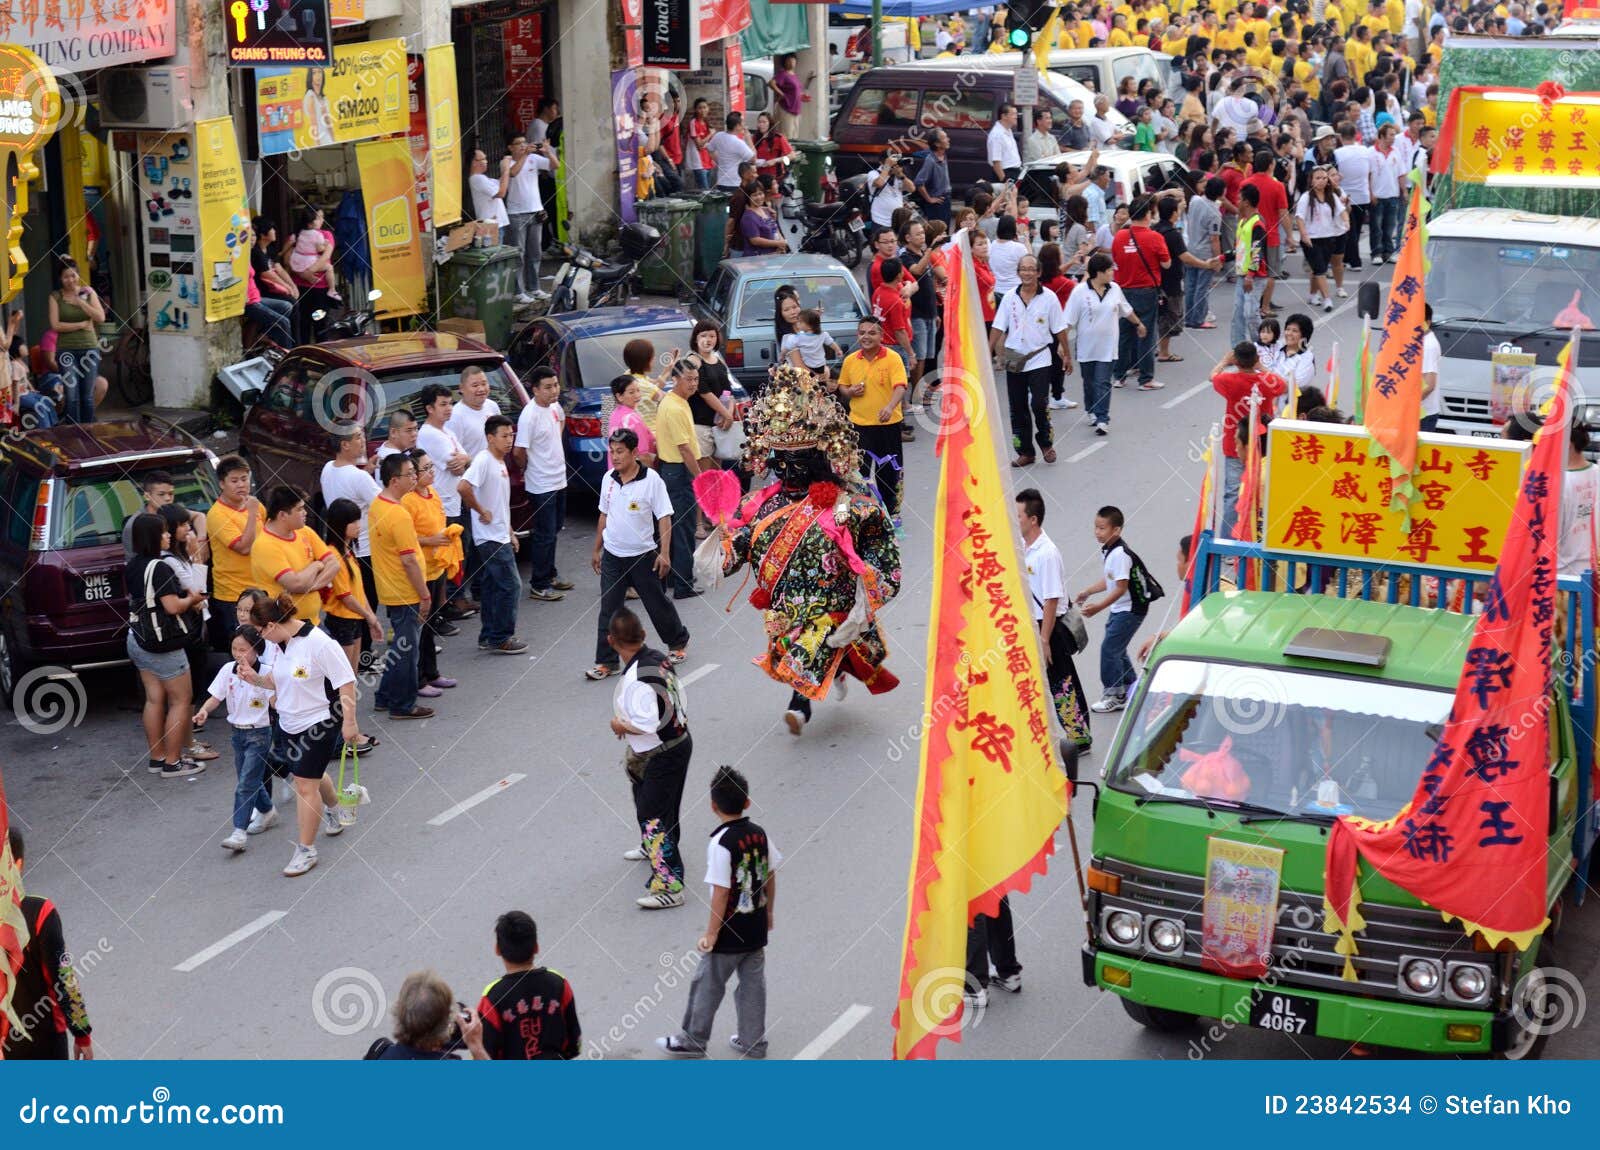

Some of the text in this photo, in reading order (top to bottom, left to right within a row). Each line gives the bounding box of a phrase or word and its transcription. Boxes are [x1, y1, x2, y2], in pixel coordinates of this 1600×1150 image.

[88, 23, 170, 58] COMPANY
[231, 47, 326, 60] CHANG THUNG CO.
[338, 96, 379, 121] RM200
[379, 222, 405, 238] DiGi
[1291, 433, 1498, 481] 詩山山寺
[1281, 505, 1498, 564] 廣澤尊王
[84, 585, 113, 601] 6112
[1271, 996, 1297, 1017] QL
[1259, 1012, 1307, 1035] 4067
